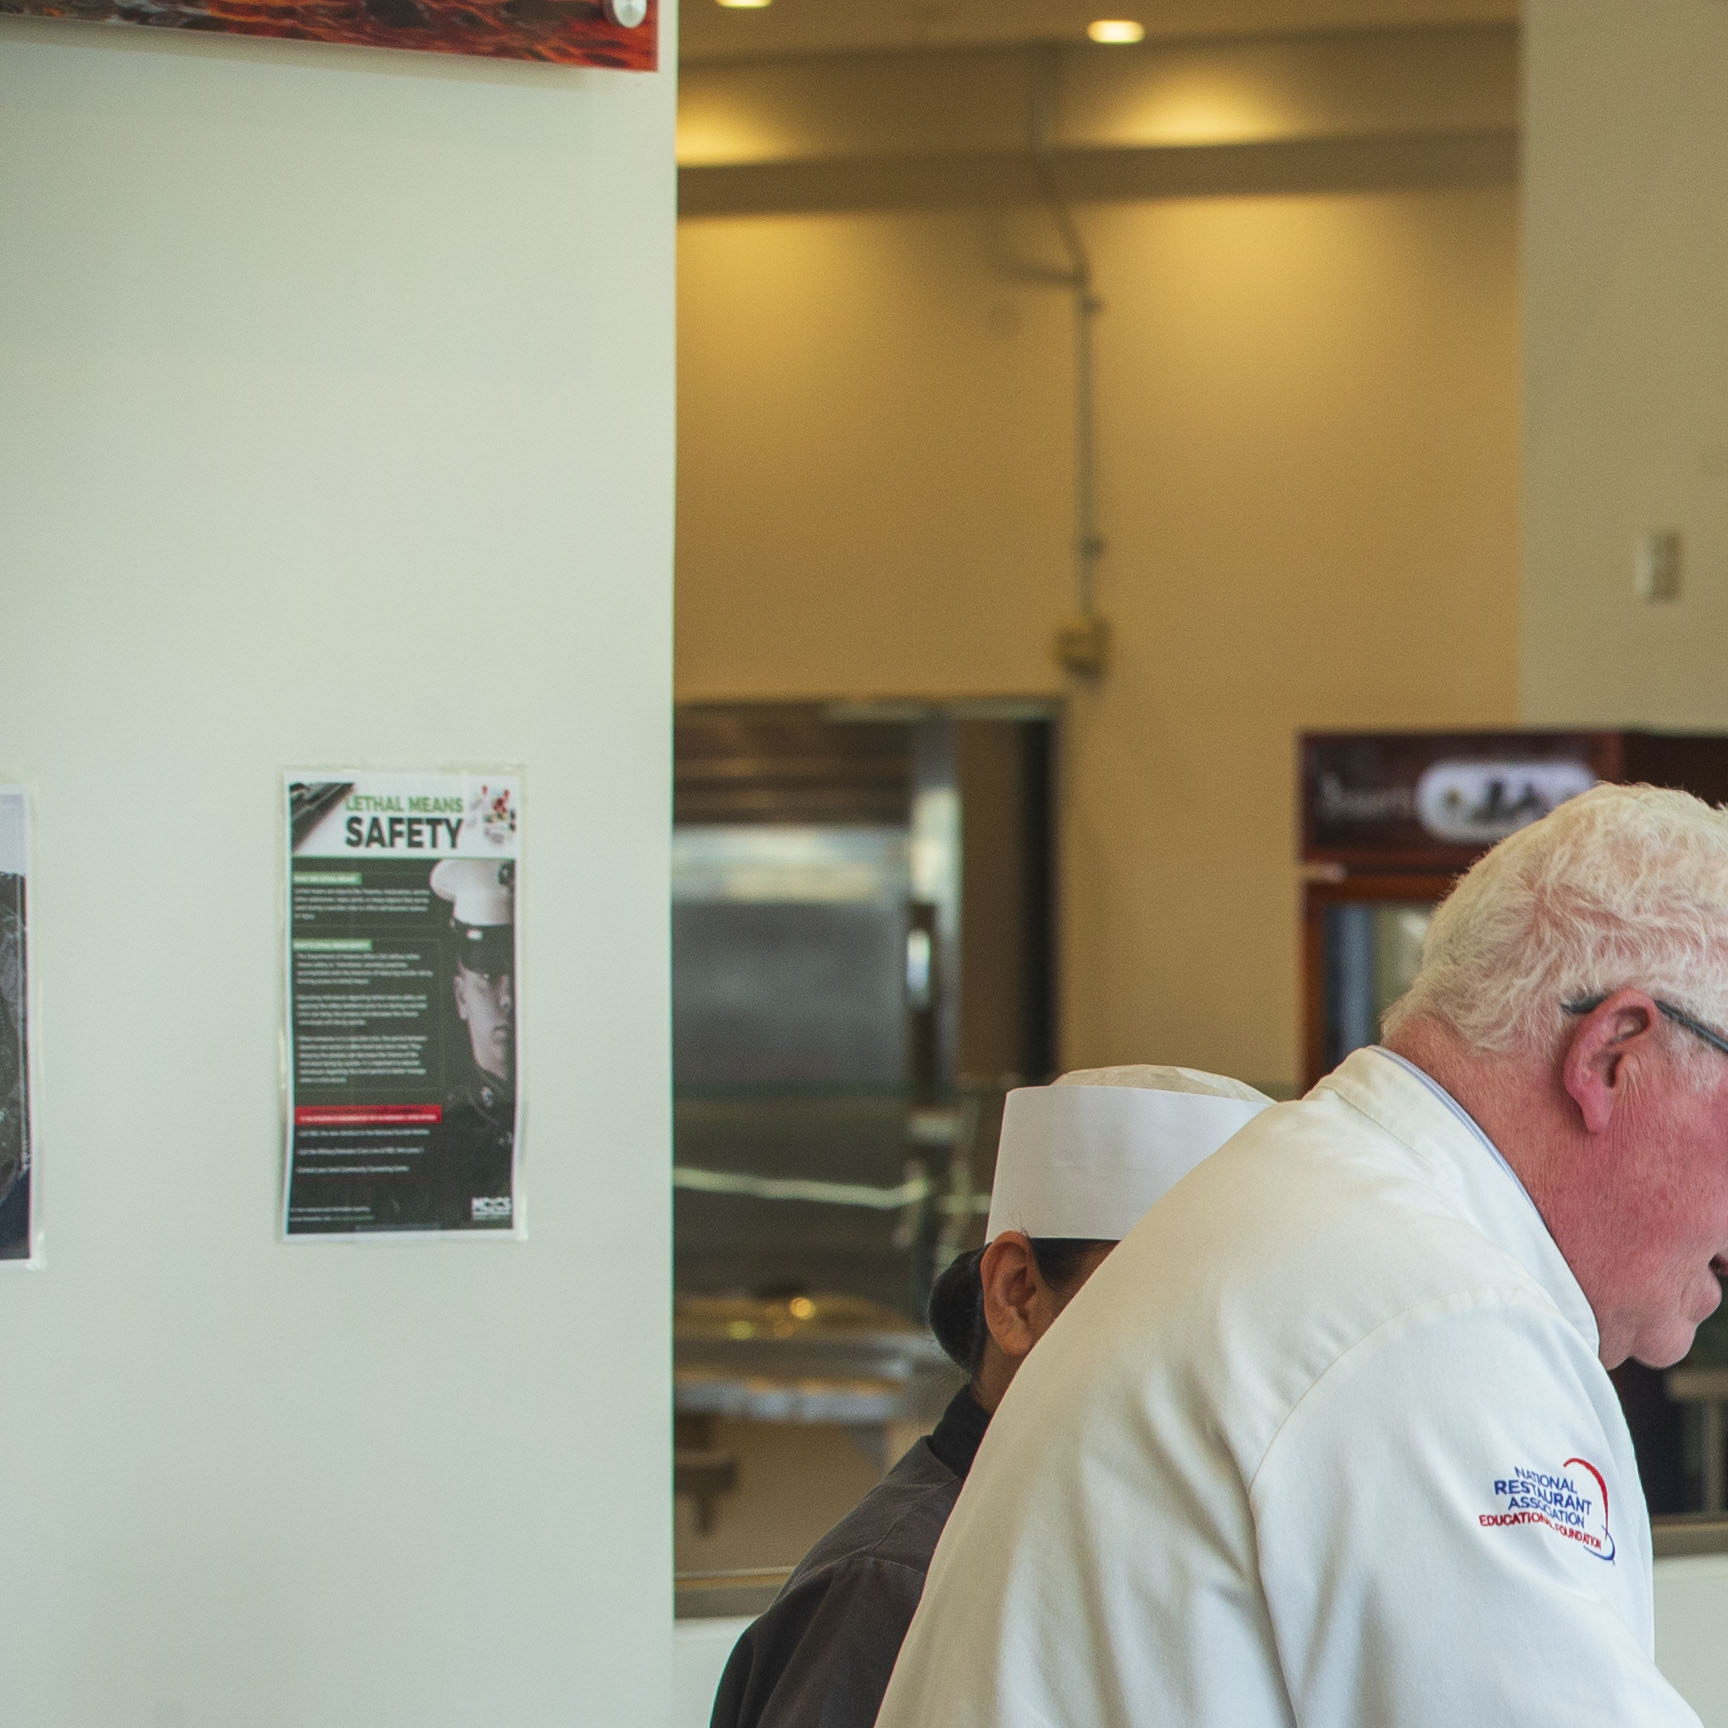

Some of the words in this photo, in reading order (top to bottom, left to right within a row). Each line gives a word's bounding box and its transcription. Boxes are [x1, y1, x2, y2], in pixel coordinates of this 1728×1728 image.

[345, 796, 404, 812] LETHAL
[408, 797, 464, 813] MEANS
[345, 816, 463, 849] SAFETY
[1514, 1466, 1578, 1494] NATIONAL
[1494, 1480, 1592, 1515] RESTAURANT
